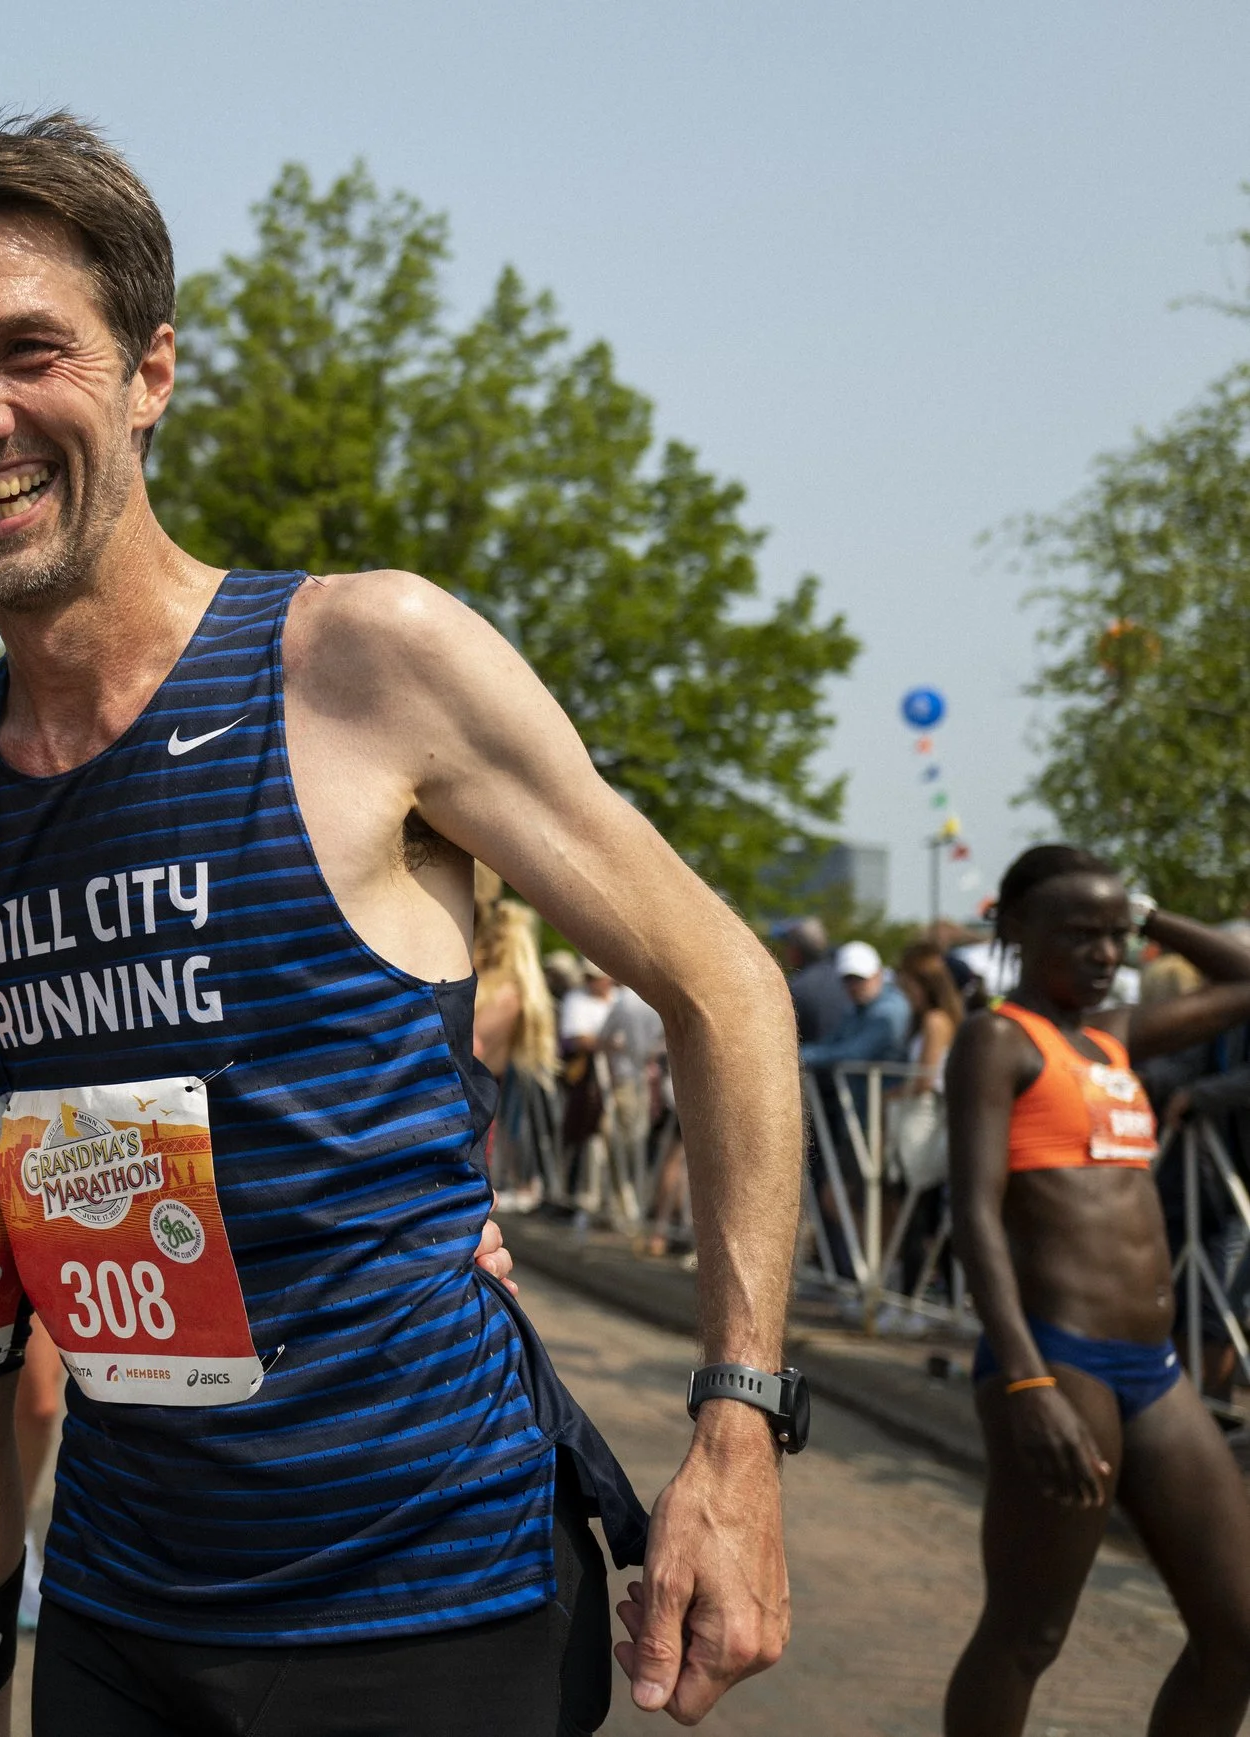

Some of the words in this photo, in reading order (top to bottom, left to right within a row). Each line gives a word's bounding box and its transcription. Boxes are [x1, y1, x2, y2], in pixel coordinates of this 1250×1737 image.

[85, 861, 209, 943] CITY
[24, 1129, 141, 1188] GRANDMA'S
[43, 1156, 161, 1216] MARATHON
[83, 1212, 102, 1222] JUNE
[60, 1260, 176, 1340] 308
[126, 1367, 171, 1380] MEMBERS
